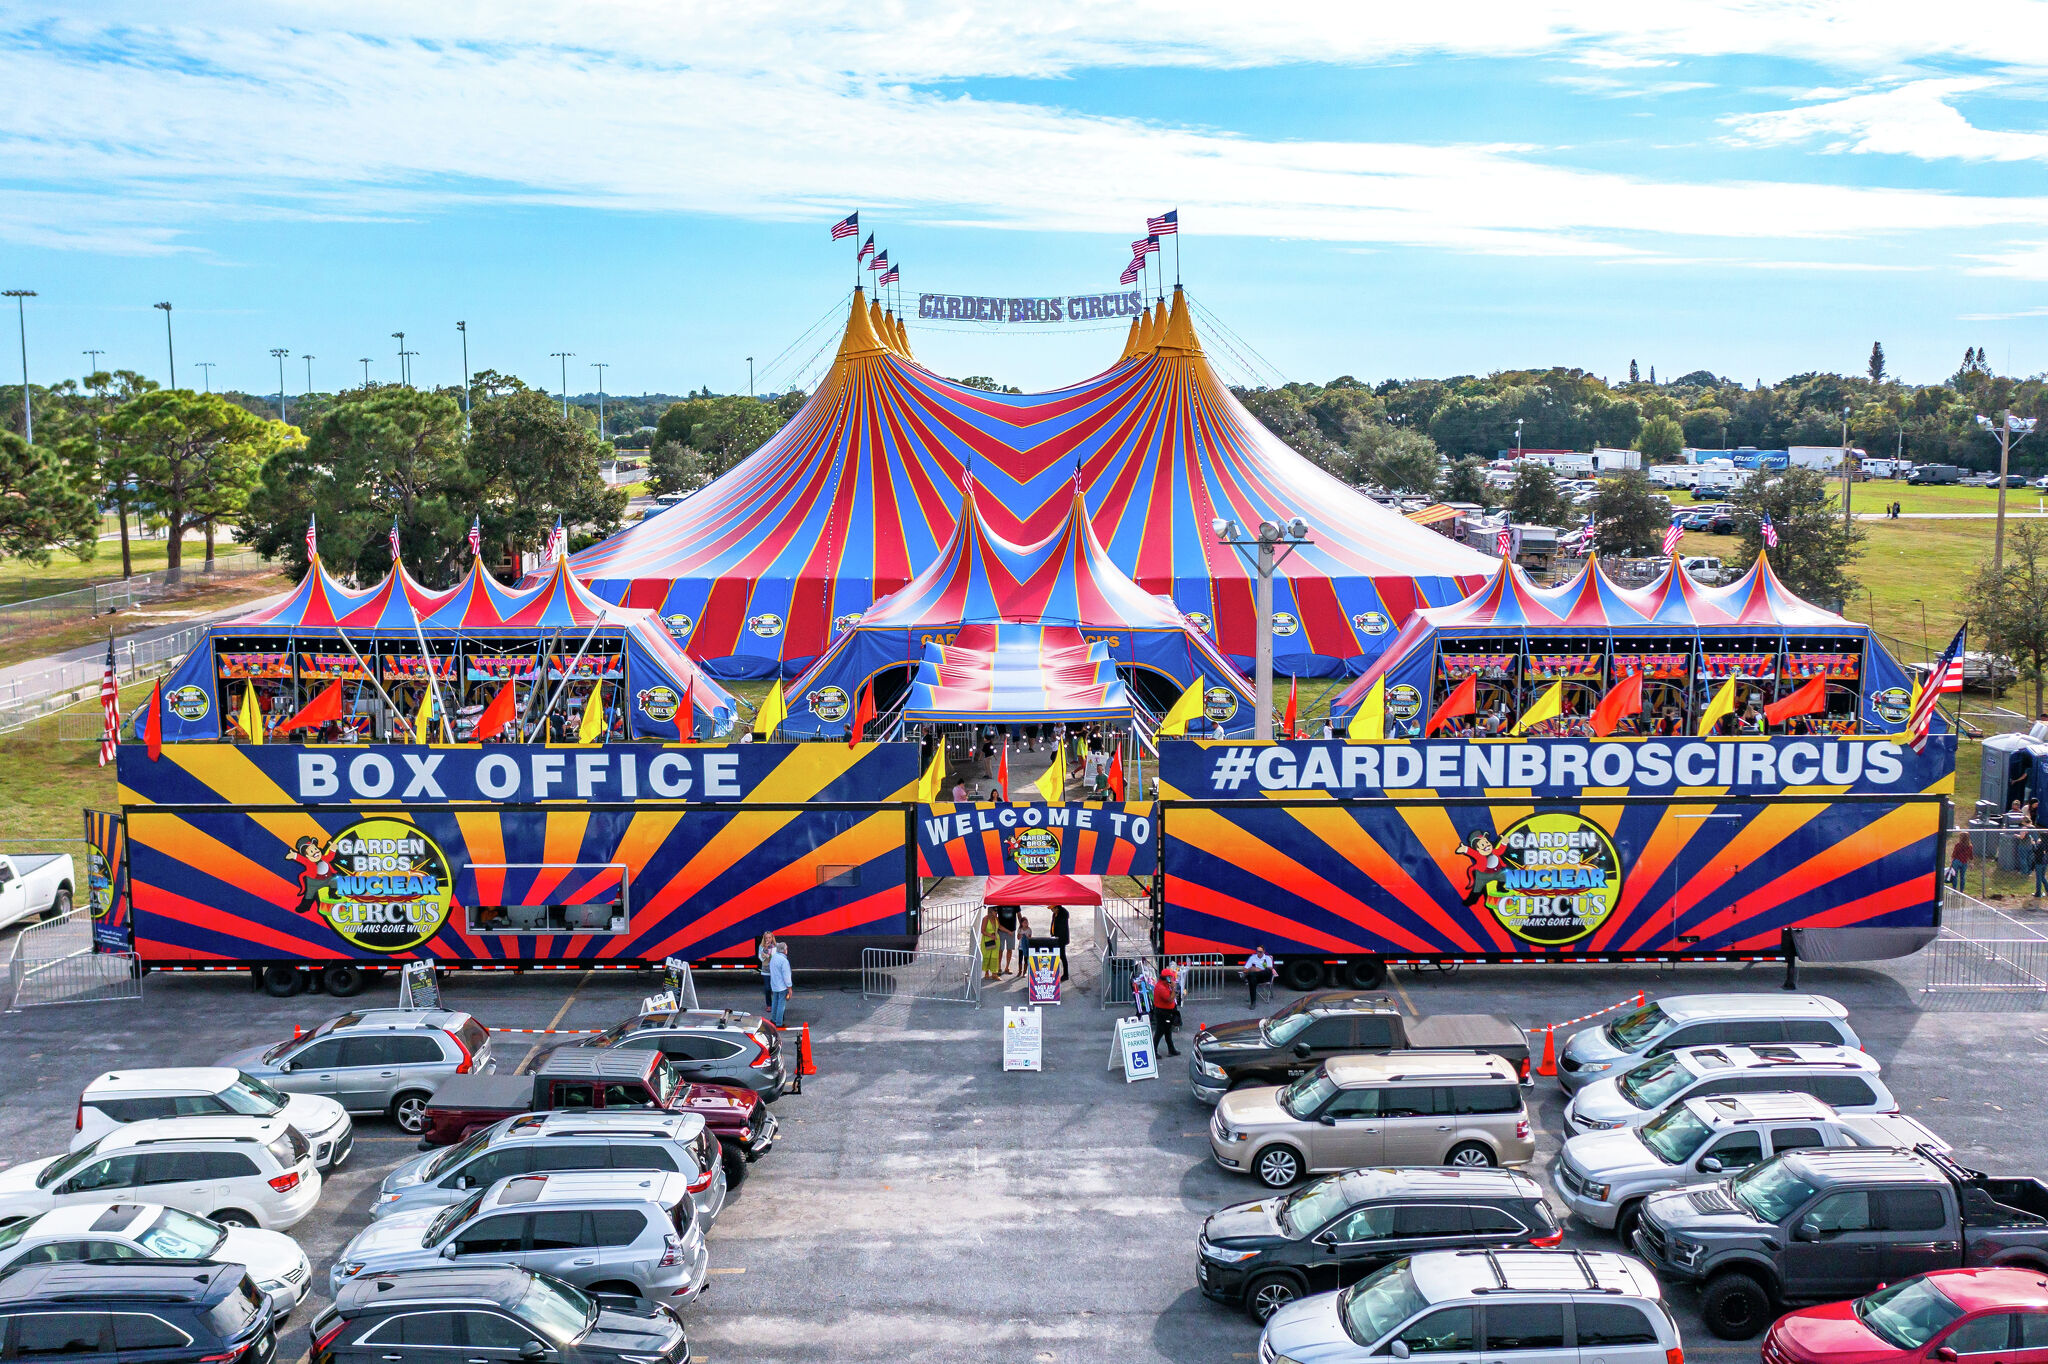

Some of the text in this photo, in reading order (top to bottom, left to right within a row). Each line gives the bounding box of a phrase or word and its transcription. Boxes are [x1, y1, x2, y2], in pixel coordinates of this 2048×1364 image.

[919, 292, 1142, 322] GARDEN BROS CIRCUS
[474, 658, 533, 666] COTTON CANDY
[1211, 741, 1903, 789] #GARDENBROSCIRCUS
[297, 752, 742, 799] BOX OFFICE
[925, 807, 1150, 846] WELCOME TO
[338, 838, 425, 855] GARDEN
[1508, 831, 1596, 849] GARDEN
[353, 855, 411, 872] BROS
[1018, 856, 1056, 864] CIRCUS
[1523, 849, 1581, 865] BROS
[336, 875, 441, 896] NUCLEAR
[1505, 868, 1608, 889] NUCLEAR
[331, 901, 440, 923] CIRCUS
[1498, 895, 1606, 917] CIRCUS
[343, 924, 432, 933] HUMANS GONE WILD!
[1509, 917, 1546, 926] HUMANS
[1547, 917, 1570, 926] GONE
[1124, 1029, 1150, 1039] RESERVED
[1127, 1039, 1149, 1047] PARKING
